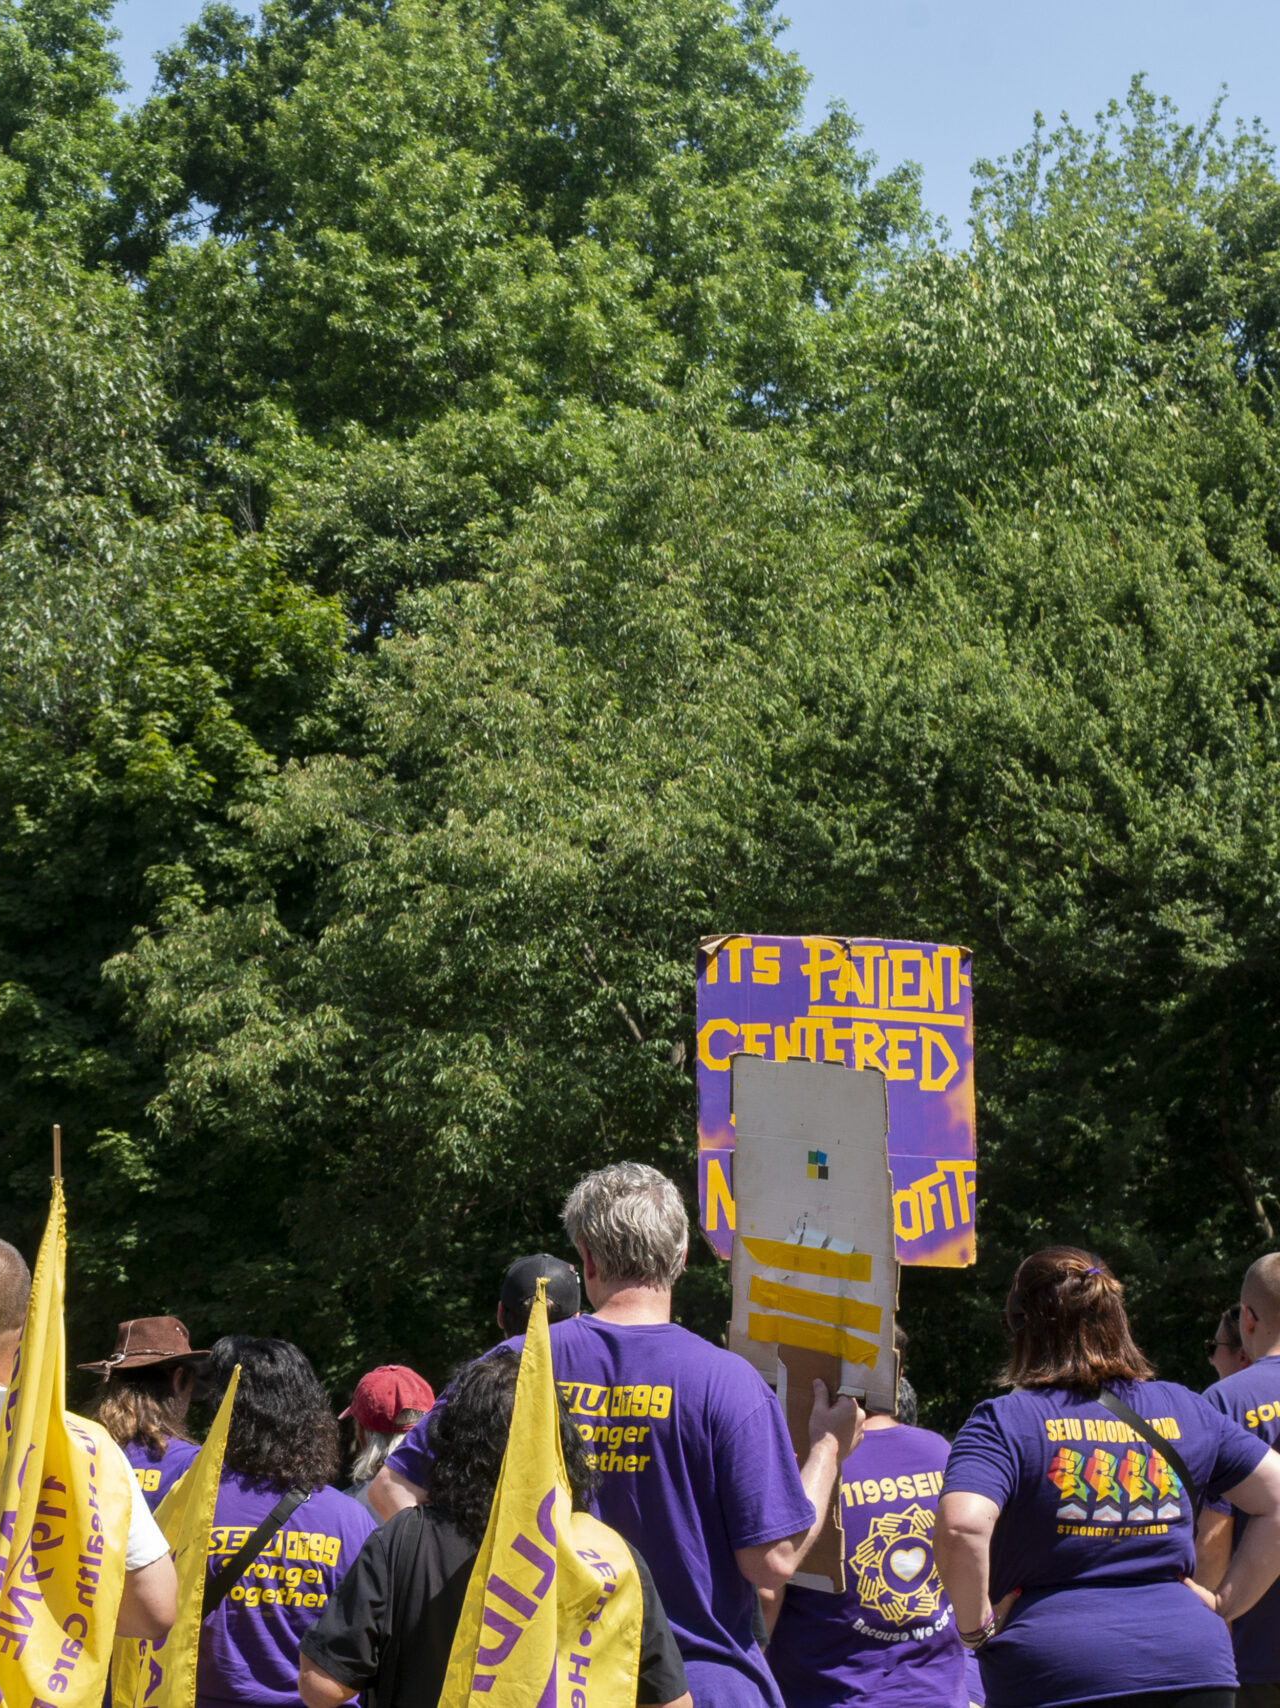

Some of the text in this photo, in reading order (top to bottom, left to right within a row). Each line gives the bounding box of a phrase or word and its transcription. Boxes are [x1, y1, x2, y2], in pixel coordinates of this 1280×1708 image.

[576, 1423, 650, 1450] onger
[1045, 1418, 1083, 1442] SEIU
[585, 1451, 651, 1472] ether
[1056, 1524, 1169, 1537] STRONGER TOGETHER
[225, 1585, 328, 1608] ogether
[852, 1617, 910, 1642] Because
[911, 1626, 934, 1641] We
